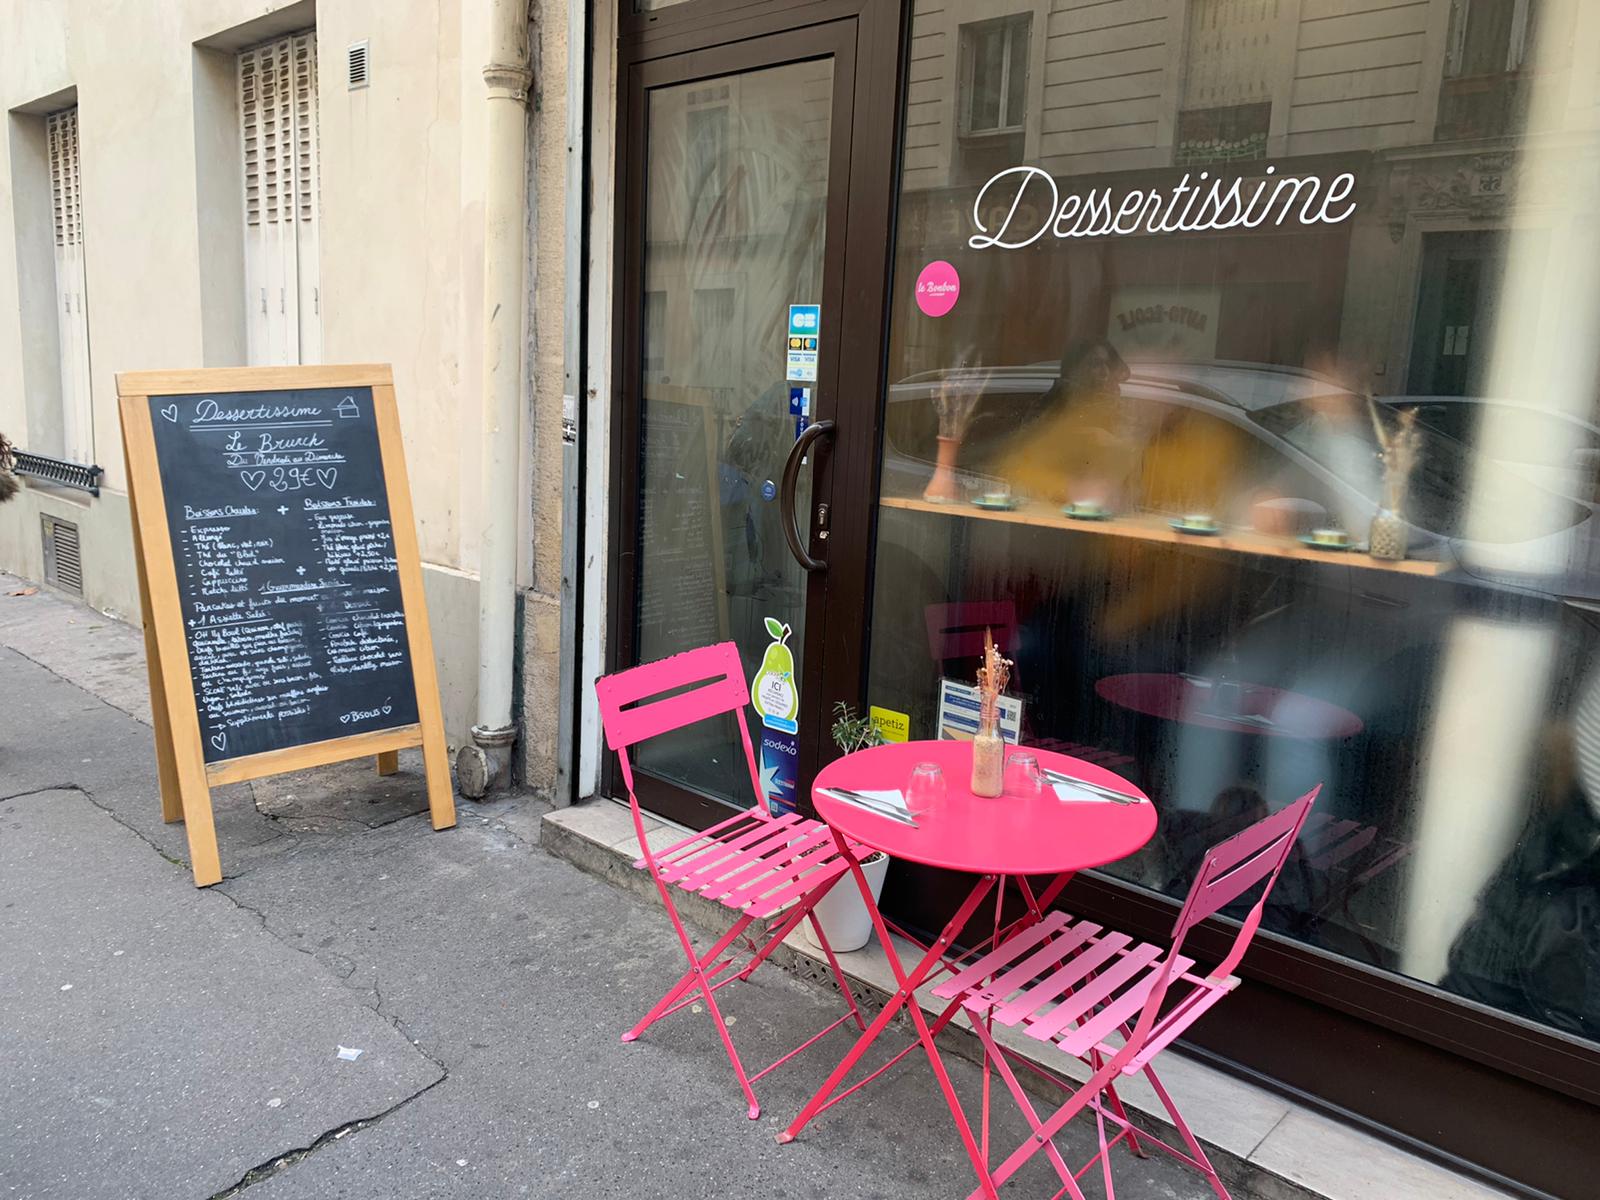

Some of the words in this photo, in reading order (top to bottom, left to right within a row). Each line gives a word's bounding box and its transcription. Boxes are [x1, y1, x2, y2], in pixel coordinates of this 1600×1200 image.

[968, 165, 1357, 249] Dessertissime
[926, 281, 957, 293] Bonbon
[193, 399, 322, 423] Dessertissime
[225, 430, 247, 451] Le
[258, 432, 325, 453] Brunch
[227, 453, 248, 466] Du
[269, 467, 316, 492] 29€
[184, 505, 224, 520] Boissons
[202, 577, 248, 588] Cappuccino
[763, 739, 797, 756] sodexo
